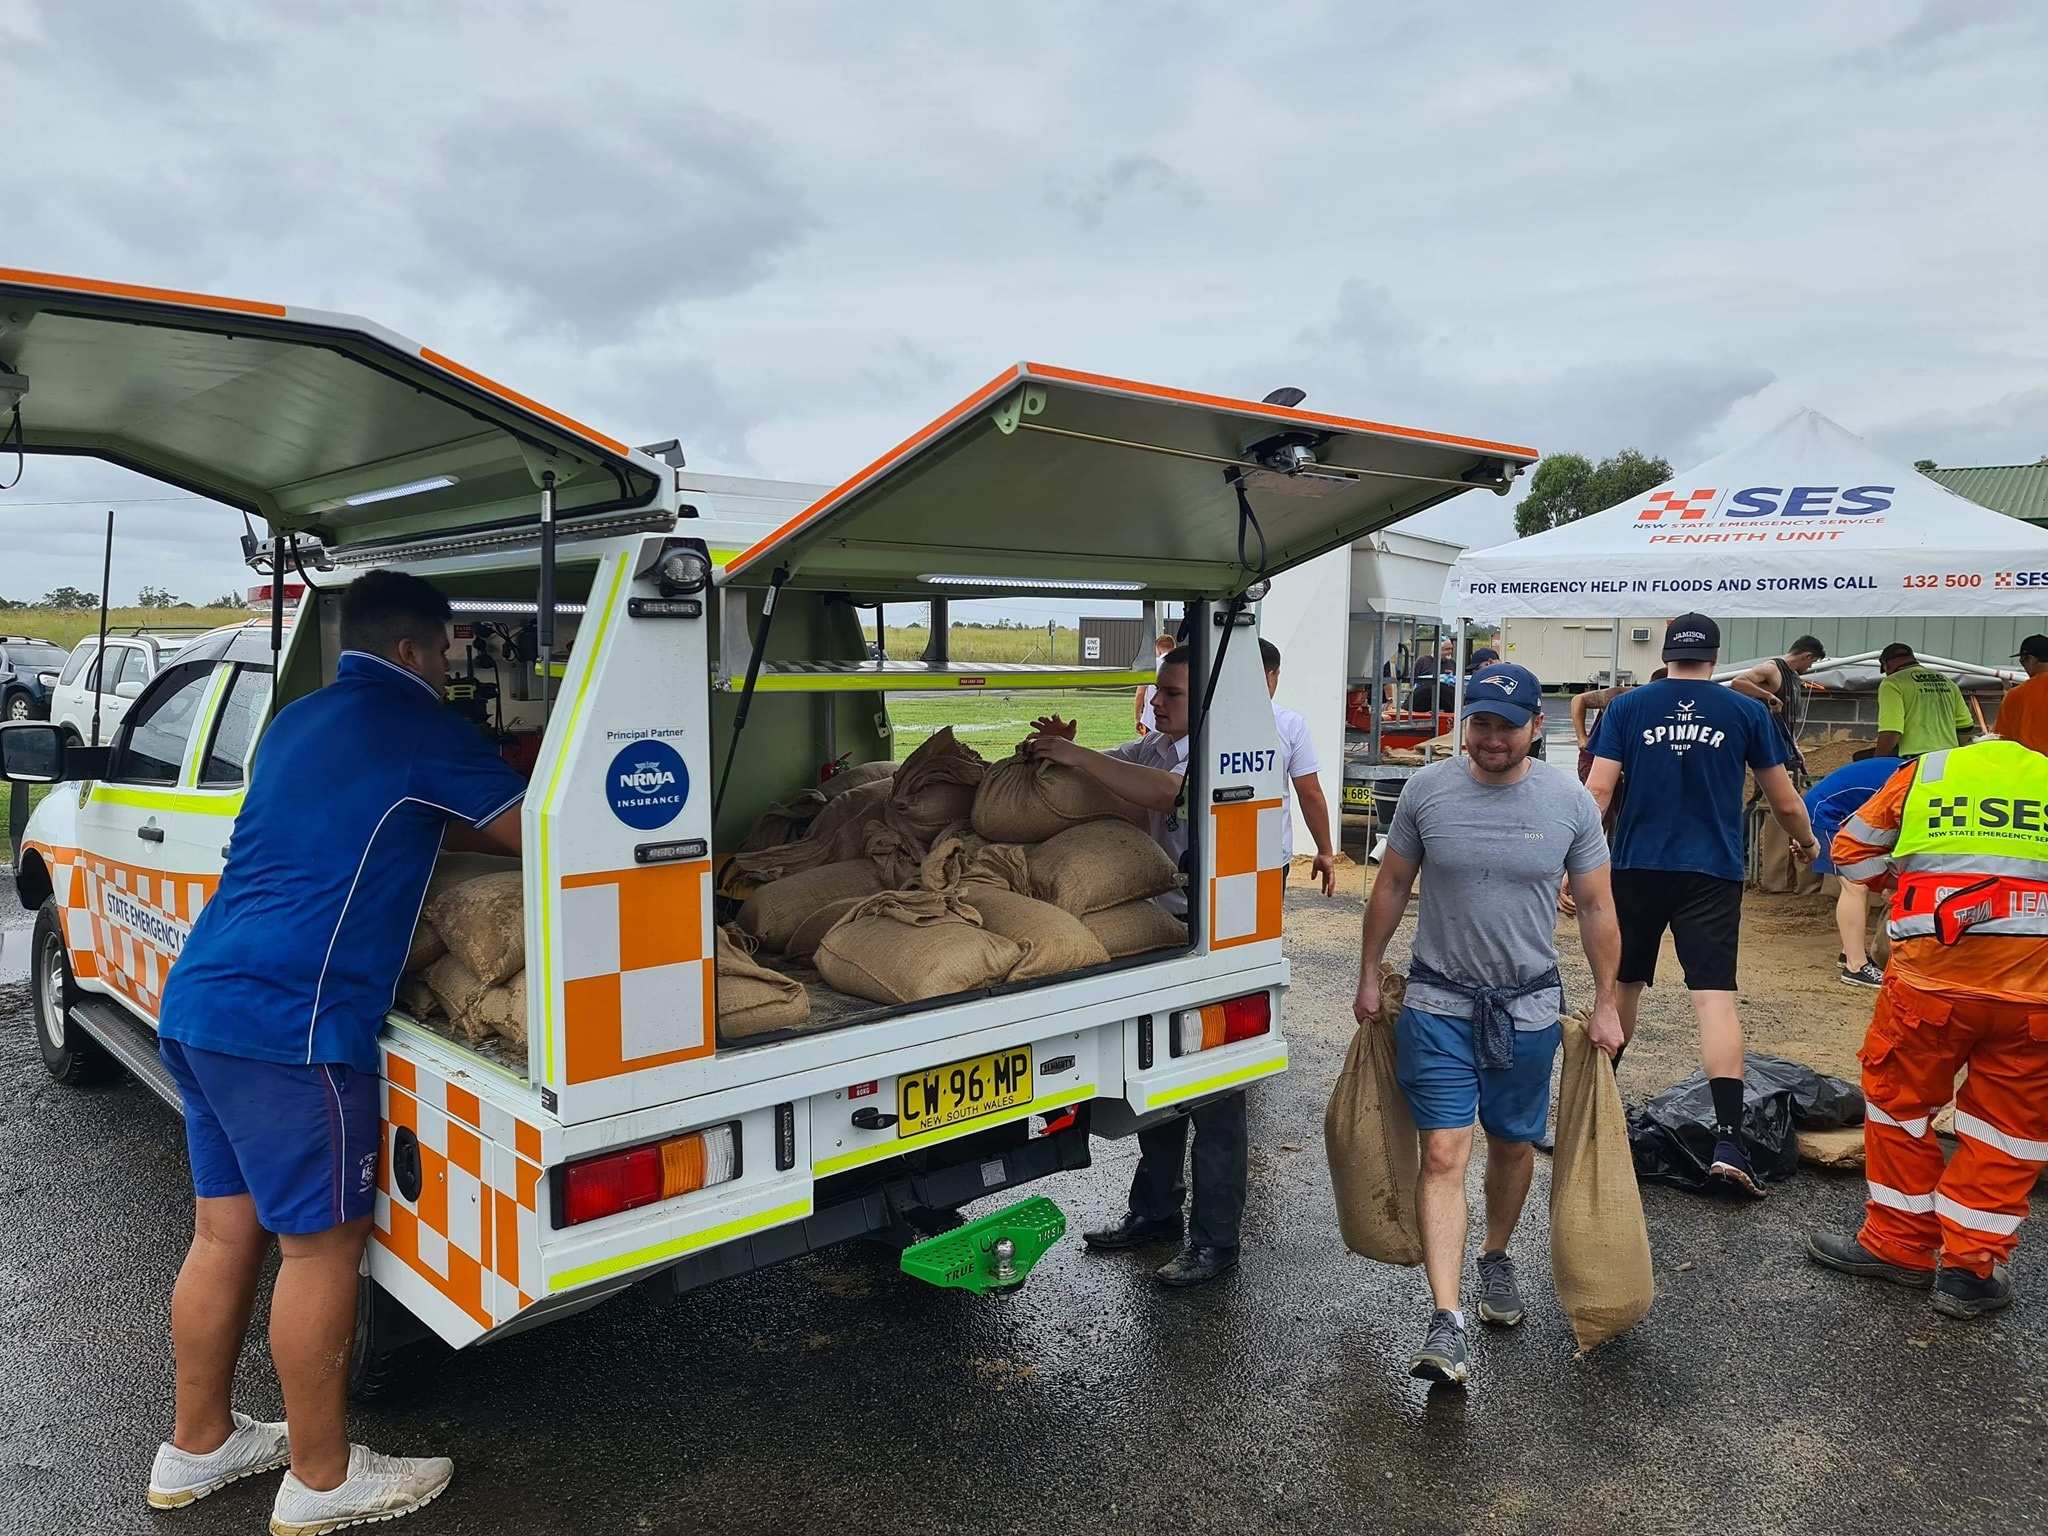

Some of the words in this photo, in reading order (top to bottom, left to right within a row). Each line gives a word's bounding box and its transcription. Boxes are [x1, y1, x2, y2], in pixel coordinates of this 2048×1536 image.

[1725, 486, 1895, 518] SES
[1671, 521, 1714, 529] STATE
[1719, 519, 1814, 528] EMERGENCY
[1818, 517, 1885, 526] SERVICE
[1649, 531, 1767, 544] PENRITH
[1776, 530, 1845, 542] UNIT
[1470, 583, 1497, 594] FOR
[1501, 581, 1588, 594] EMERGENCY
[1591, 581, 1628, 593] HELP
[1632, 580, 1648, 592] IN
[1652, 579, 1713, 592] FLOODS
[1717, 579, 1751, 591] AND
[1756, 577, 1828, 590] STORMS
[1833, 575, 1878, 590] CALL
[1903, 575, 1938, 588] 132
[1944, 574, 1982, 588] 500
[1676, 712, 1693, 721] THE
[607, 729, 648, 741] Principal
[651, 729, 684, 738] Partner
[1642, 723, 1725, 748] SPINNER
[1220, 749, 1276, 775] PEN57
[620, 771, 676, 788] NRMA
[617, 795, 681, 808] INSURANCE
[1978, 831, 2033, 840] EMERGENCY
[107, 892, 130, 924] STATE
[129, 903, 180, 953] EMERGENCY
[920, 1115, 942, 1130] NEW
[947, 1105, 979, 1122] SOUTH
[983, 1095, 1015, 1113] WALES
[944, 1263, 975, 1283] TRUE
